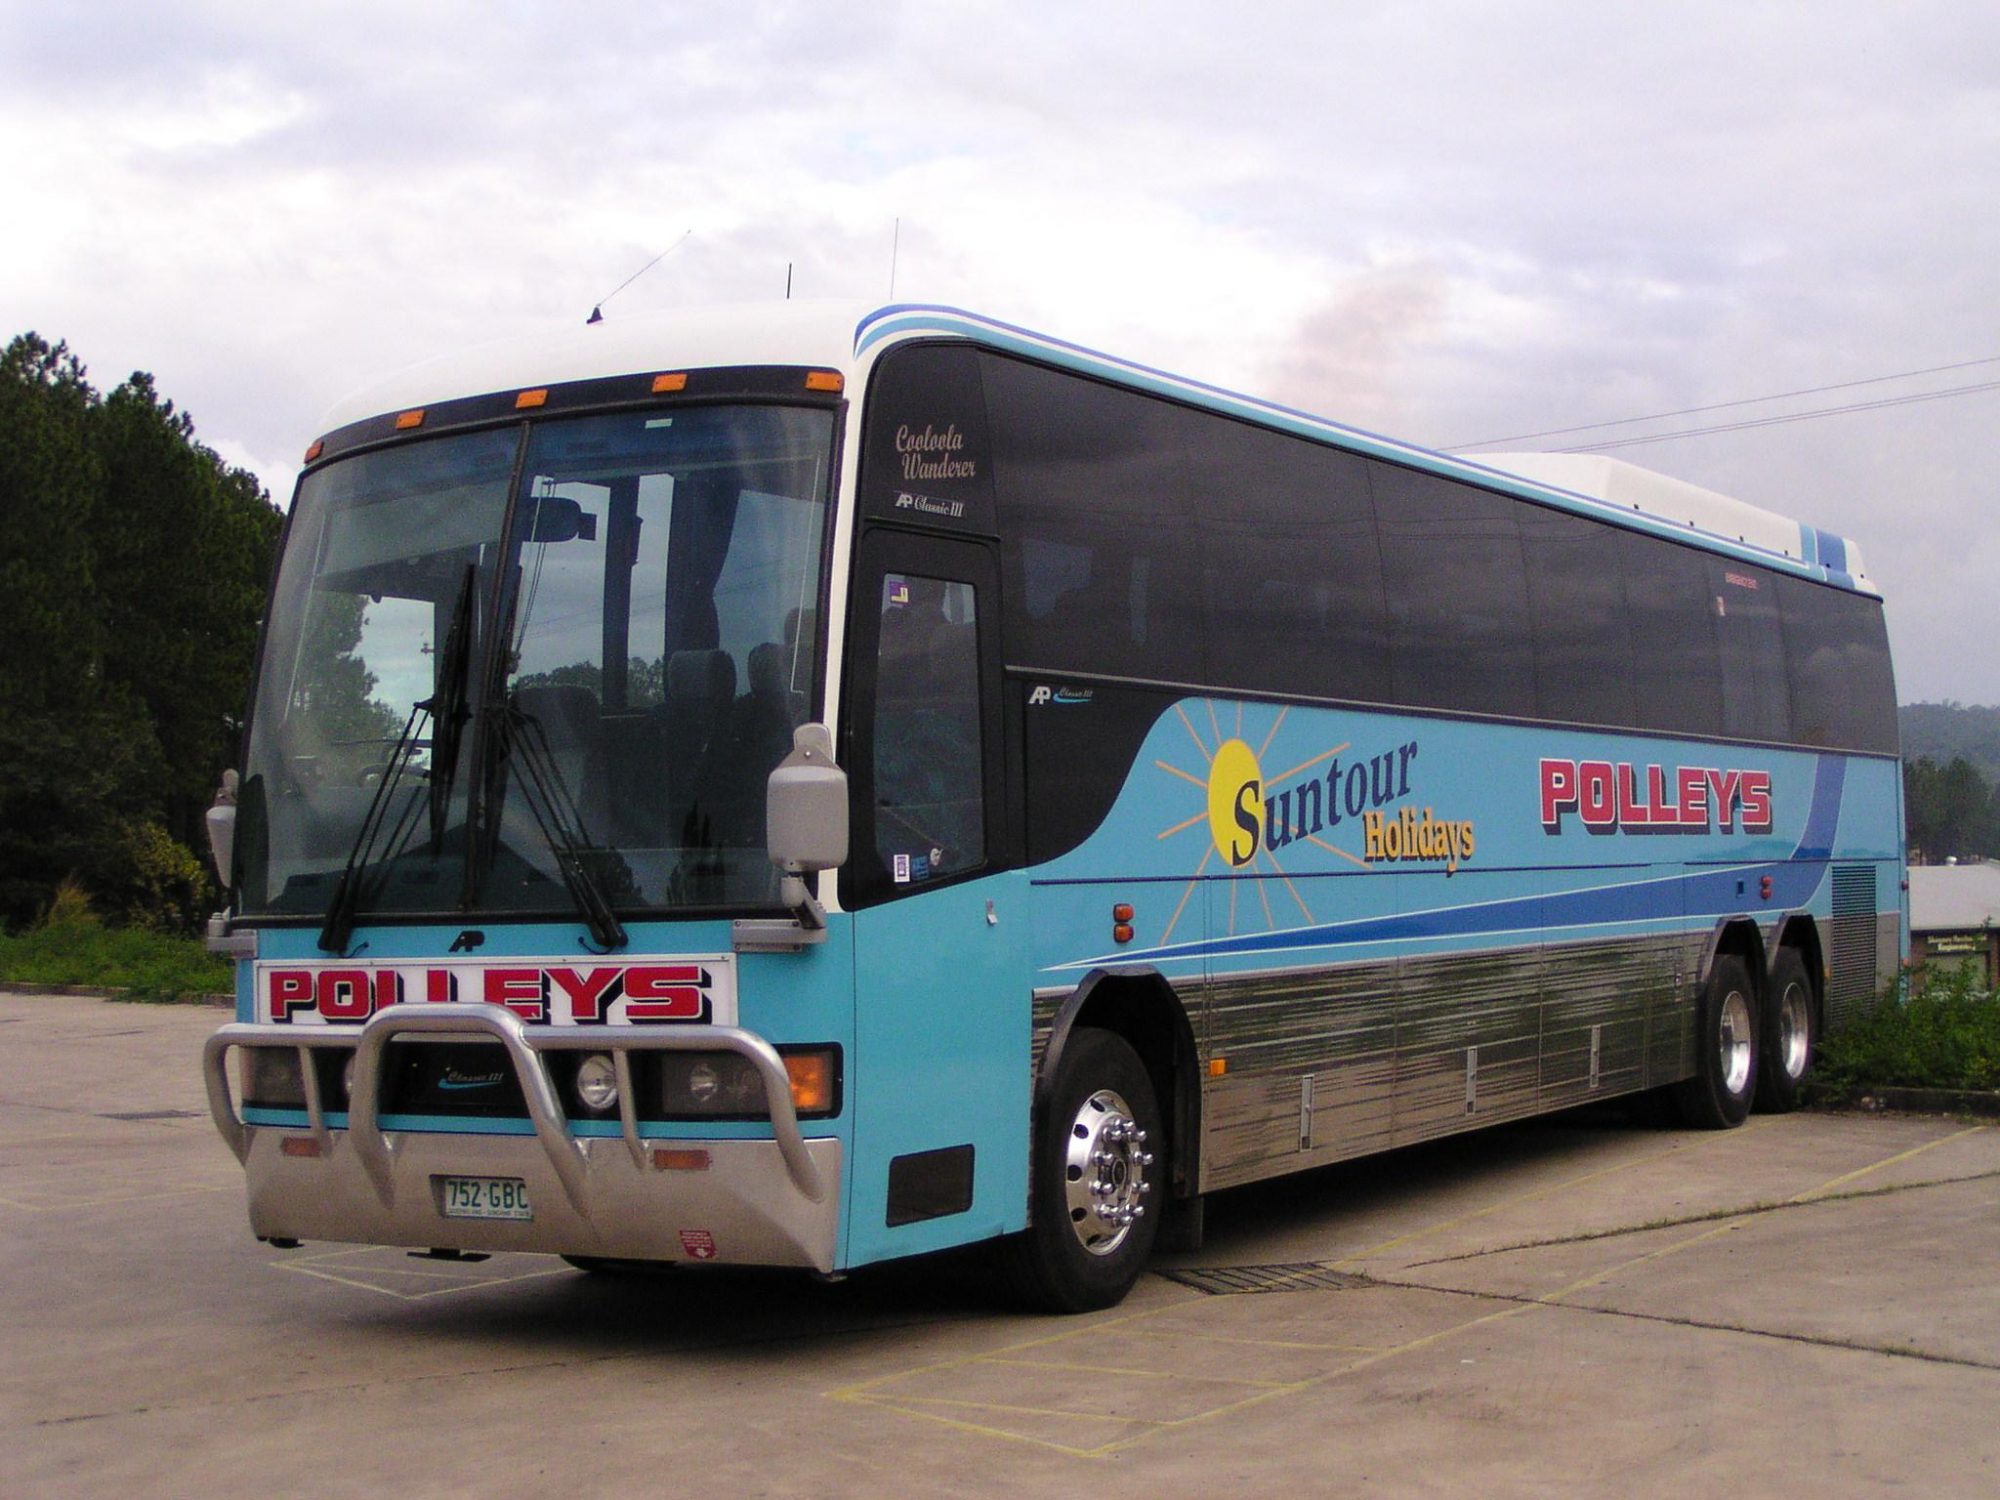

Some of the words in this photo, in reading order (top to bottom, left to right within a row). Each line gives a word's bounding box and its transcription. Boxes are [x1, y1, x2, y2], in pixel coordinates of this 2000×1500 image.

[896, 424, 963, 452] Cooloola
[901, 452, 976, 479] Wanderer
[1232, 741, 1418, 867] Suntour
[1539, 758, 1773, 836] POLLEYS
[1362, 806, 1475, 878] Holidays
